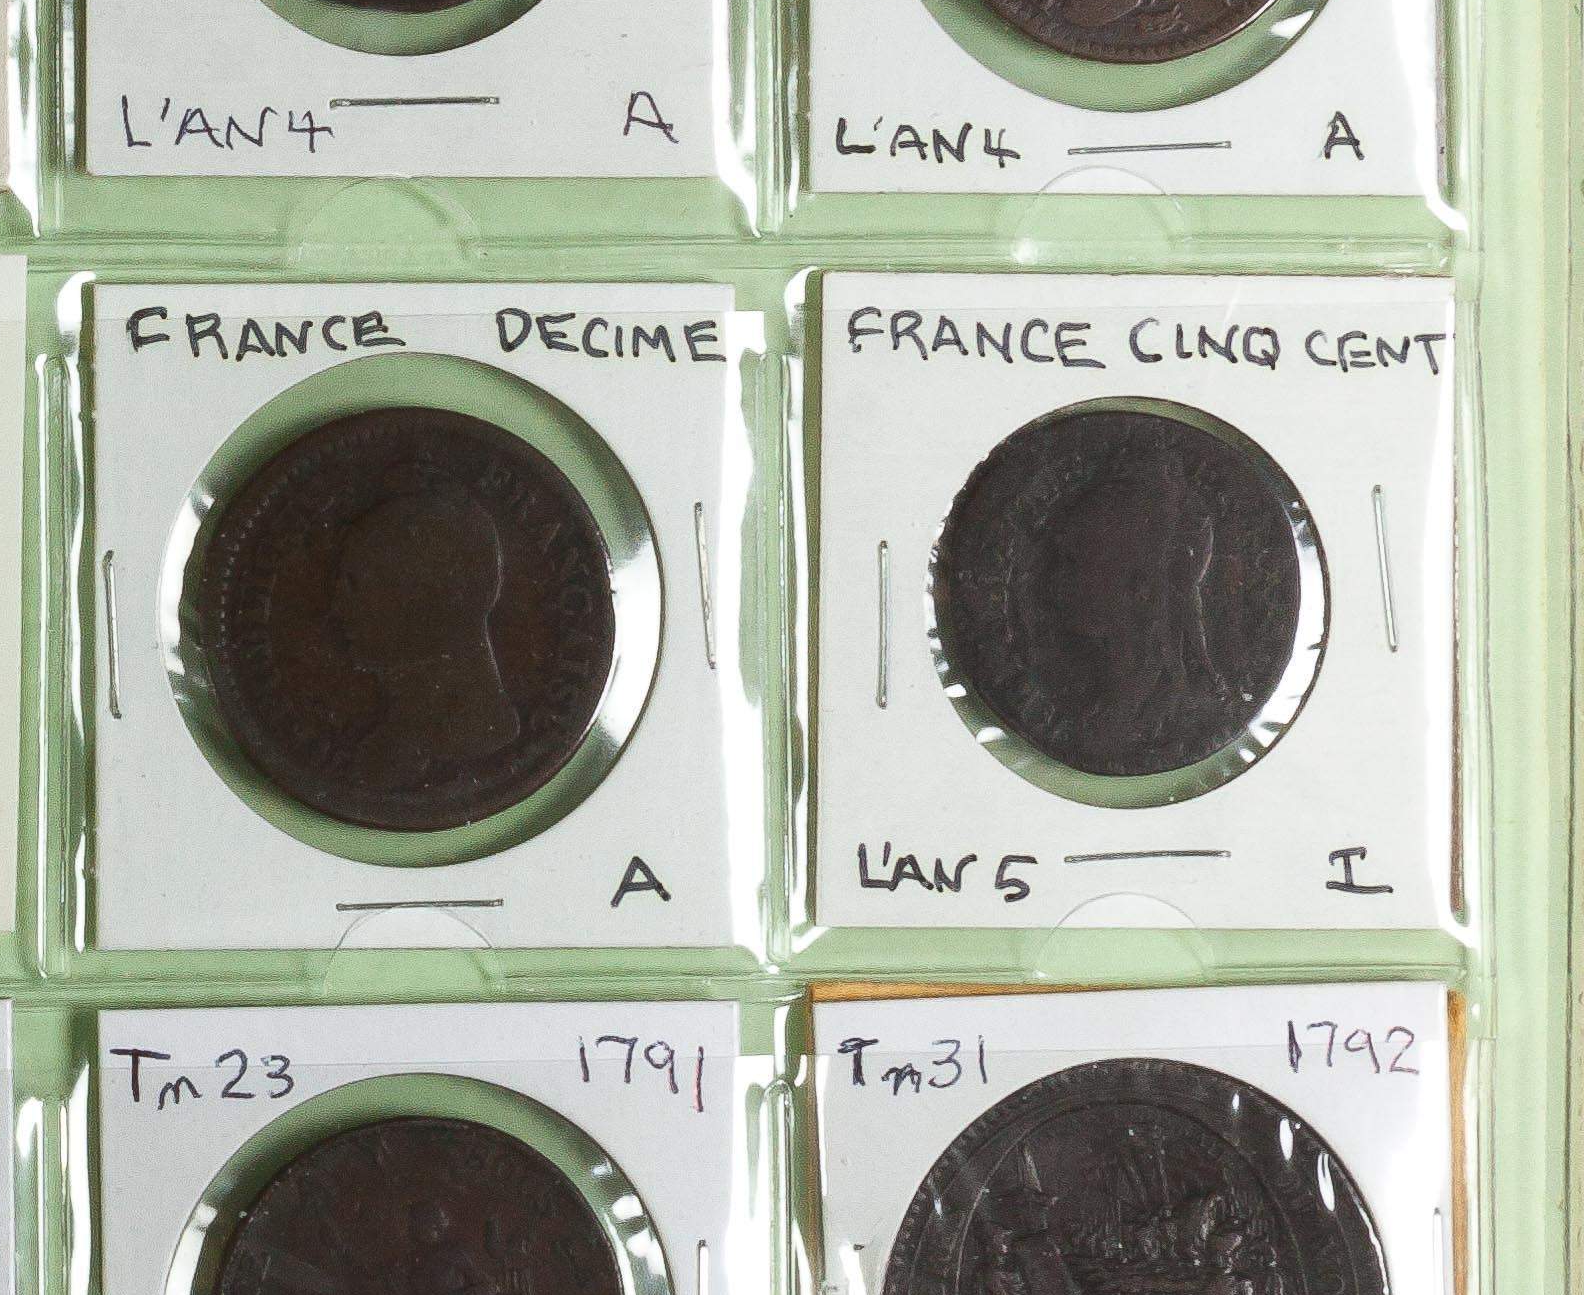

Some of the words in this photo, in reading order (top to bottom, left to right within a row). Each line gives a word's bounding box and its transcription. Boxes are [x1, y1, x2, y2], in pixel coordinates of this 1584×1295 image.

[622, 90, 680, 145] A
[1322, 110, 1366, 162] A
[125, 305, 407, 363] FRANCE
[494, 307, 728, 364] DECIME
[847, 305, 1107, 370] FRANCE
[1304, 329, 1447, 376] CENT
[609, 855, 672, 909] A
[993, 854, 1039, 904] 5
[1324, 845, 1395, 895] I
[578, 1034, 705, 1114] 1791
[1286, 1019, 1420, 1075] 1792
